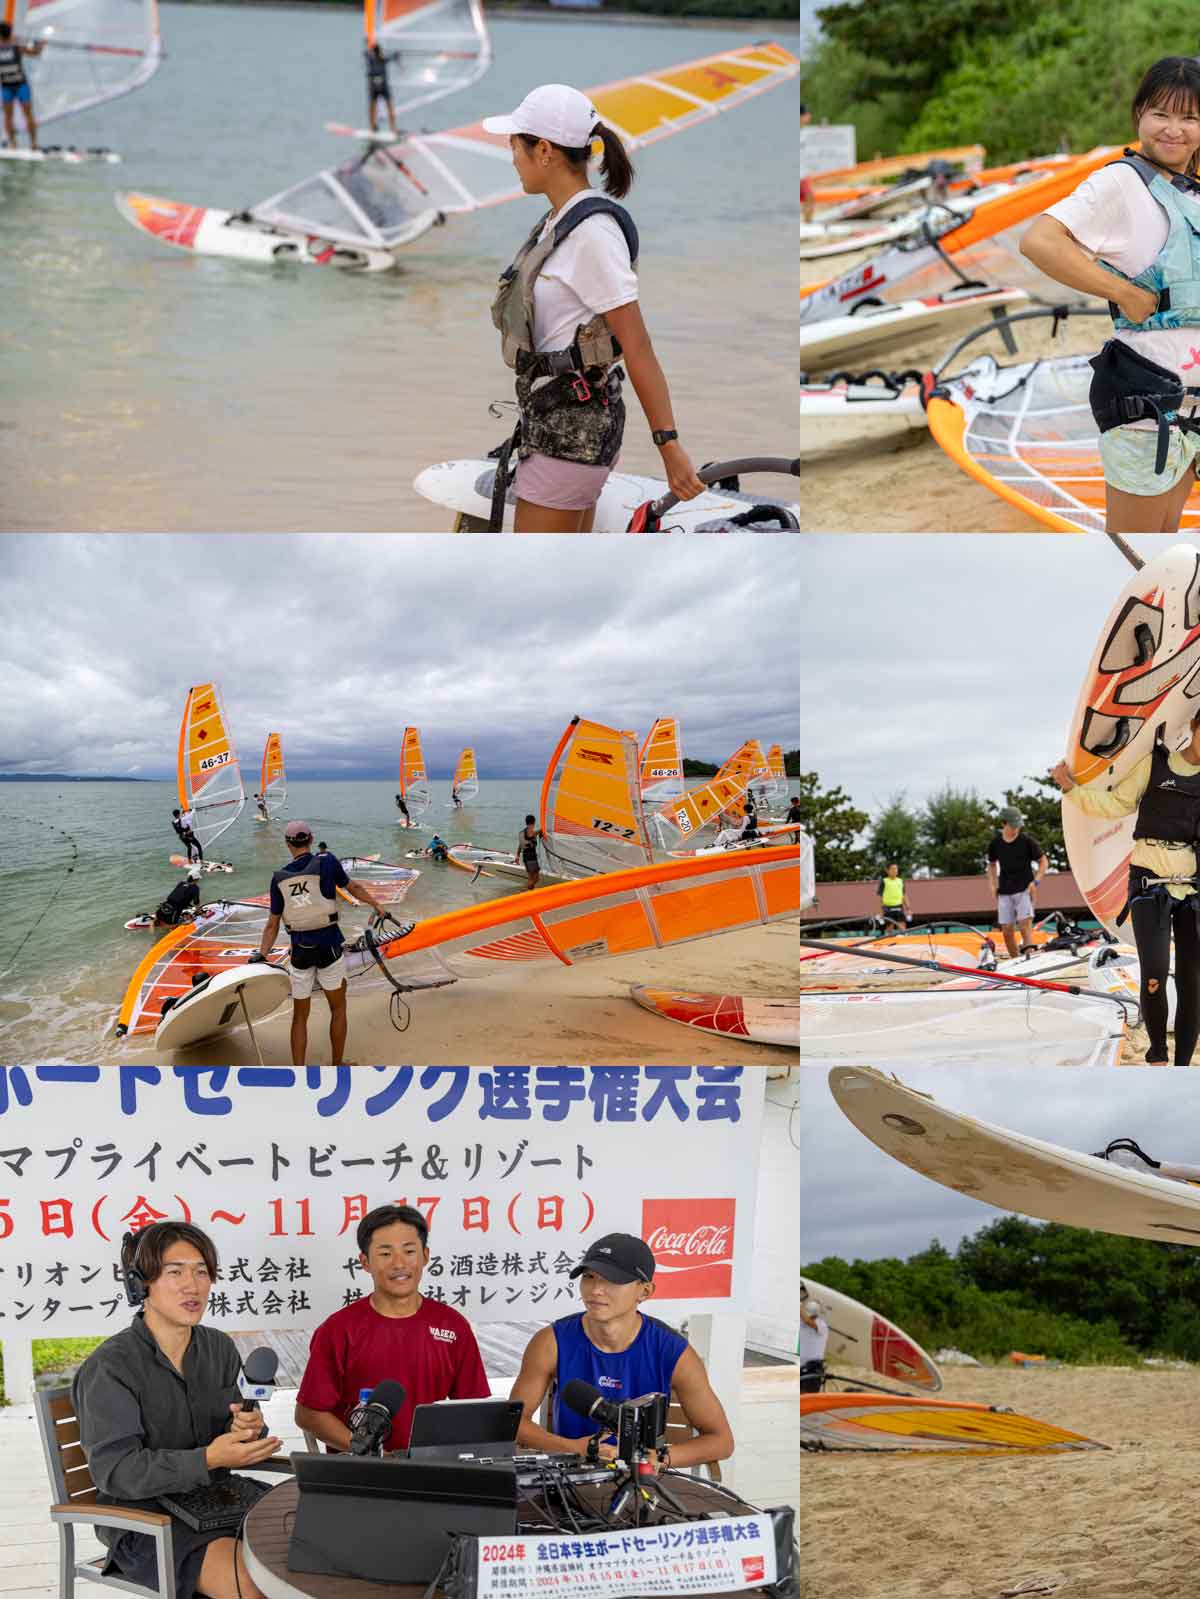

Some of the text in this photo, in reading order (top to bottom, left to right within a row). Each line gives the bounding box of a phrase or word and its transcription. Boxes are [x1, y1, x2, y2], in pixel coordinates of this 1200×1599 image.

[201, 752, 229, 769] 46-37
[592, 818, 635, 839] 12-2
[288, 881, 310, 896] ZK
[429, 1327, 457, 1341] WASED
[482, 1522, 760, 1562] 2024年 全日本学生ボードセーリング選手権大会
